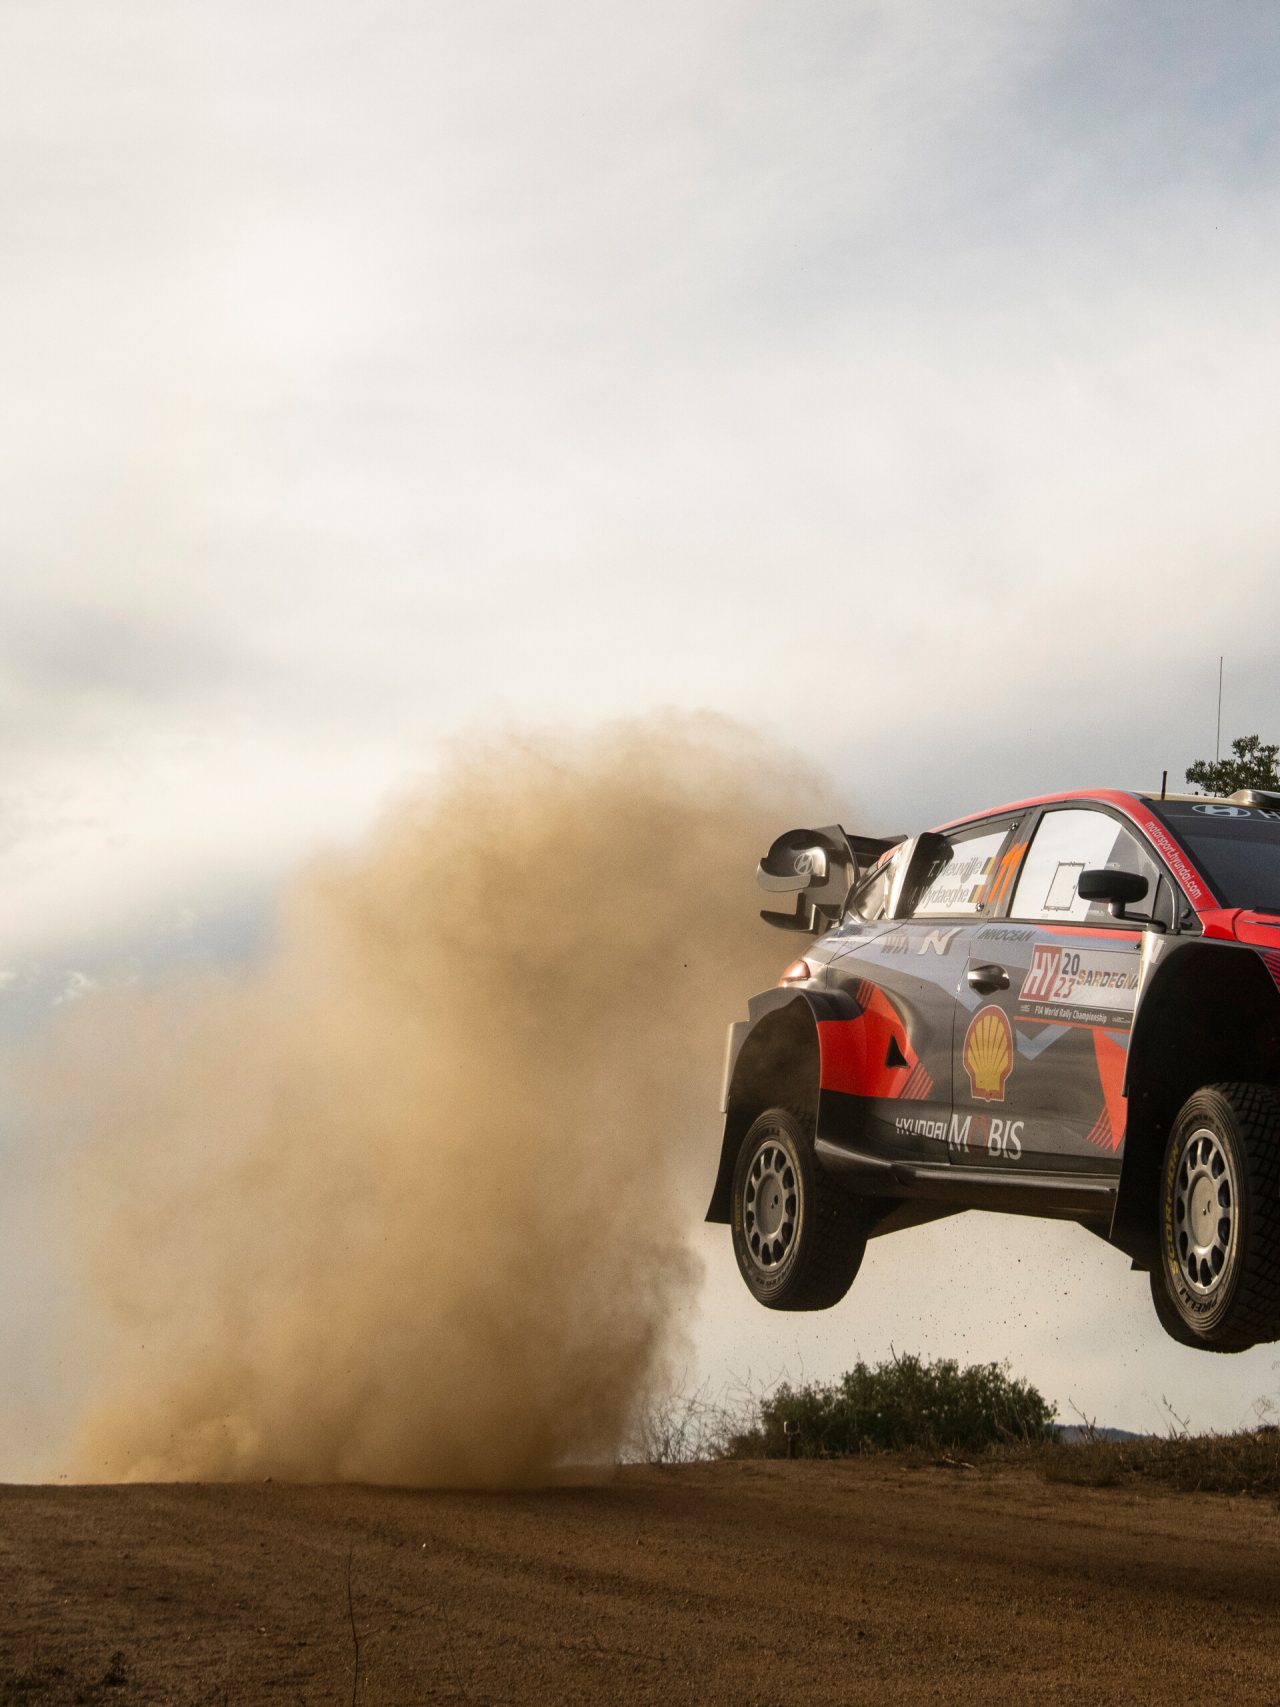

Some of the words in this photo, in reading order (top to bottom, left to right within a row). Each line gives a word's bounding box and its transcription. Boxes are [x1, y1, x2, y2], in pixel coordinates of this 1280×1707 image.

[1145, 821, 1202, 899] motorsport.hyundai.com
[917, 927, 964, 956] N
[977, 928, 1037, 942] INNOCEAN
[1023, 951, 1060, 996] HY
[1061, 952, 1080, 976] 20
[1053, 976, 1076, 999] 23
[1076, 969, 1139, 990] SARDEGNA
[1034, 1005, 1044, 1014] FIA
[1044, 1006, 1059, 1017] World
[1058, 1008, 1072, 1020] Rally
[1072, 1010, 1108, 1024] Championship
[895, 1117, 948, 1141] HYUNDAI
